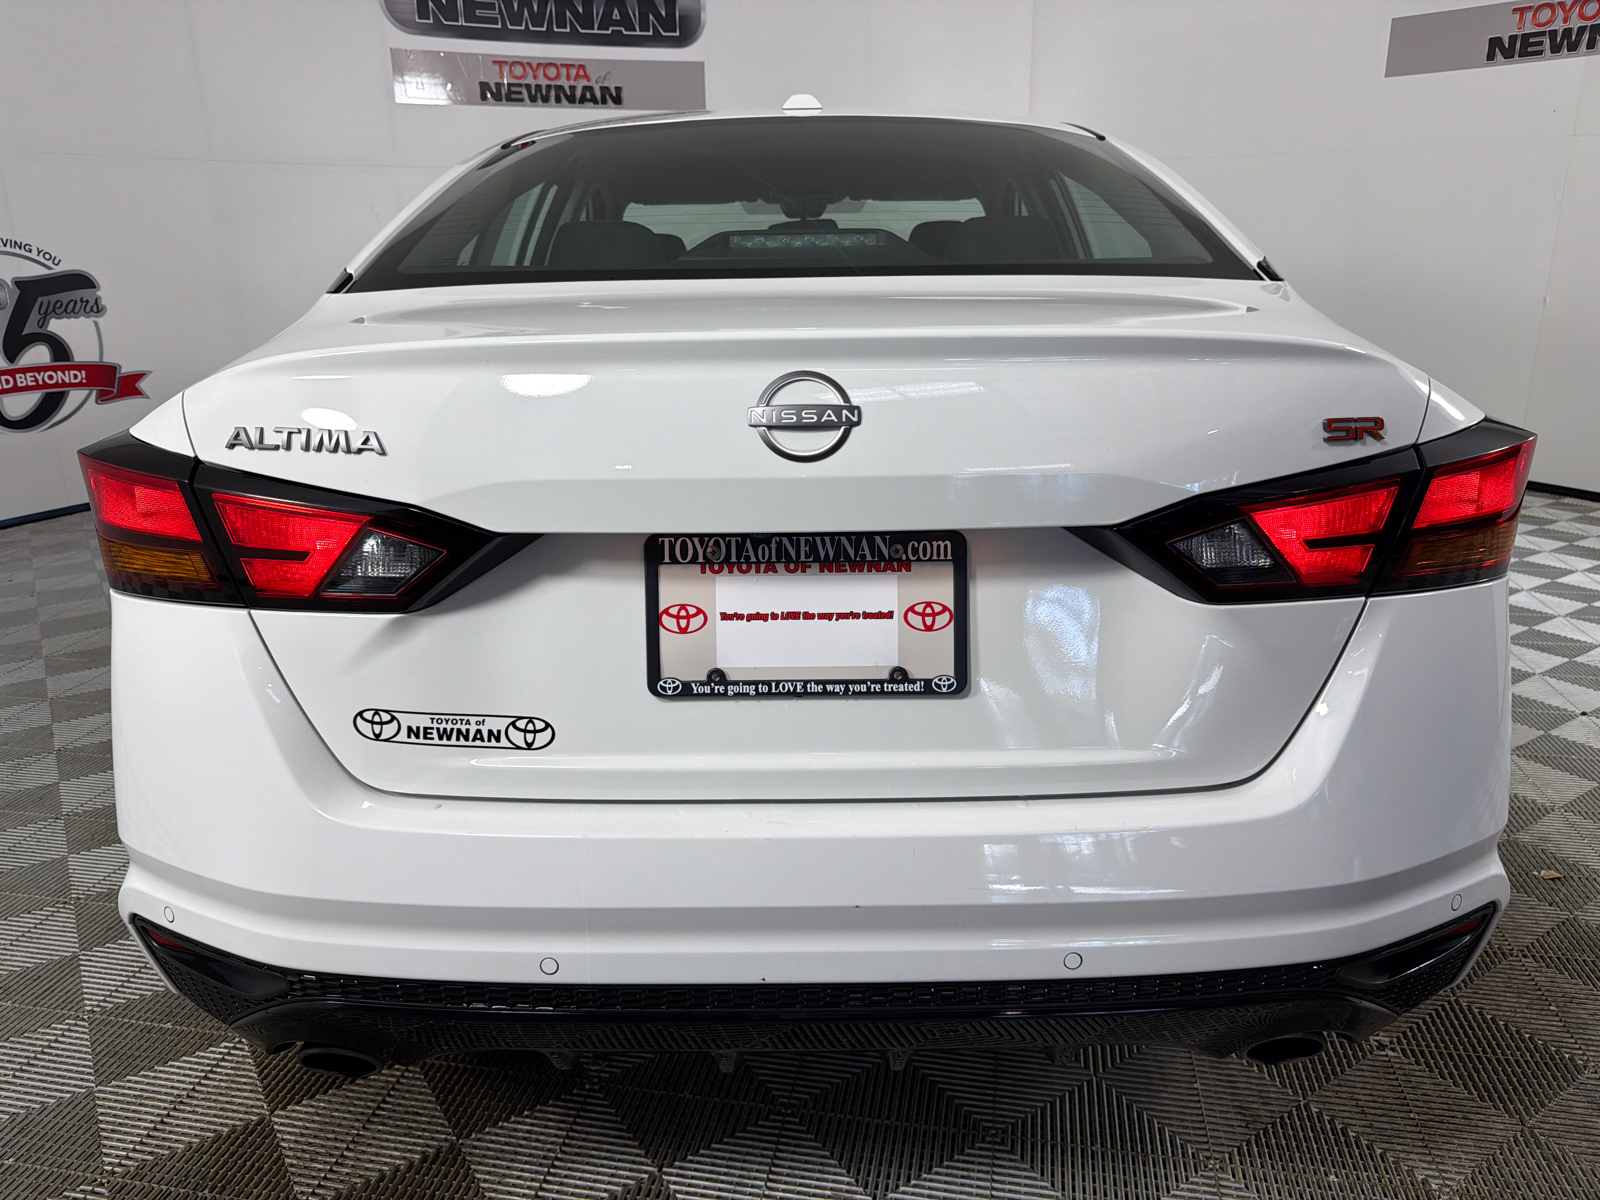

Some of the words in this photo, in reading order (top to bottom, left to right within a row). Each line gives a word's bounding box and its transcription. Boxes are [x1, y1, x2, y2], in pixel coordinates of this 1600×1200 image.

[415, 0, 680, 36] NEWNAN
[492, 60, 591, 82] TOYOTA
[595, 71, 612, 84] of
[478, 81, 623, 105] NEWNAN
[0, 237, 33, 254] VING
[36, 246, 62, 267] YOU
[37, 296, 104, 329] years
[0, 375, 14, 390] D
[15, 370, 87, 387] BEYOND!
[751, 409, 858, 423] NISSAN
[1322, 417, 1385, 441] SR
[225, 426, 388, 456] ALTIMA
[700, 562, 778, 574] TOYOTA
[784, 562, 811, 574] OF
[819, 561, 911, 573] NEWNAN
[719, 611, 745, 621] You're
[746, 612, 769, 622] going
[770, 611, 779, 620] to
[780, 611, 801, 620] LOVE
[802, 611, 816, 620] the
[817, 612, 834, 621] way
[834, 611, 861, 621] you're
[862, 610, 894, 619] treated!
[691, 682, 725, 694] You're
[727, 682, 756, 696] going
[758, 683, 768, 693] to
[771, 681, 804, 693] LOVE
[806, 681, 823, 692] the
[826, 684, 845, 695] way
[848, 681, 882, 695] you're
[884, 680, 925, 692] treated!
[429, 717, 471, 726] TOYOTA
[475, 718, 486, 727] of
[406, 725, 502, 743] NEWNAN
